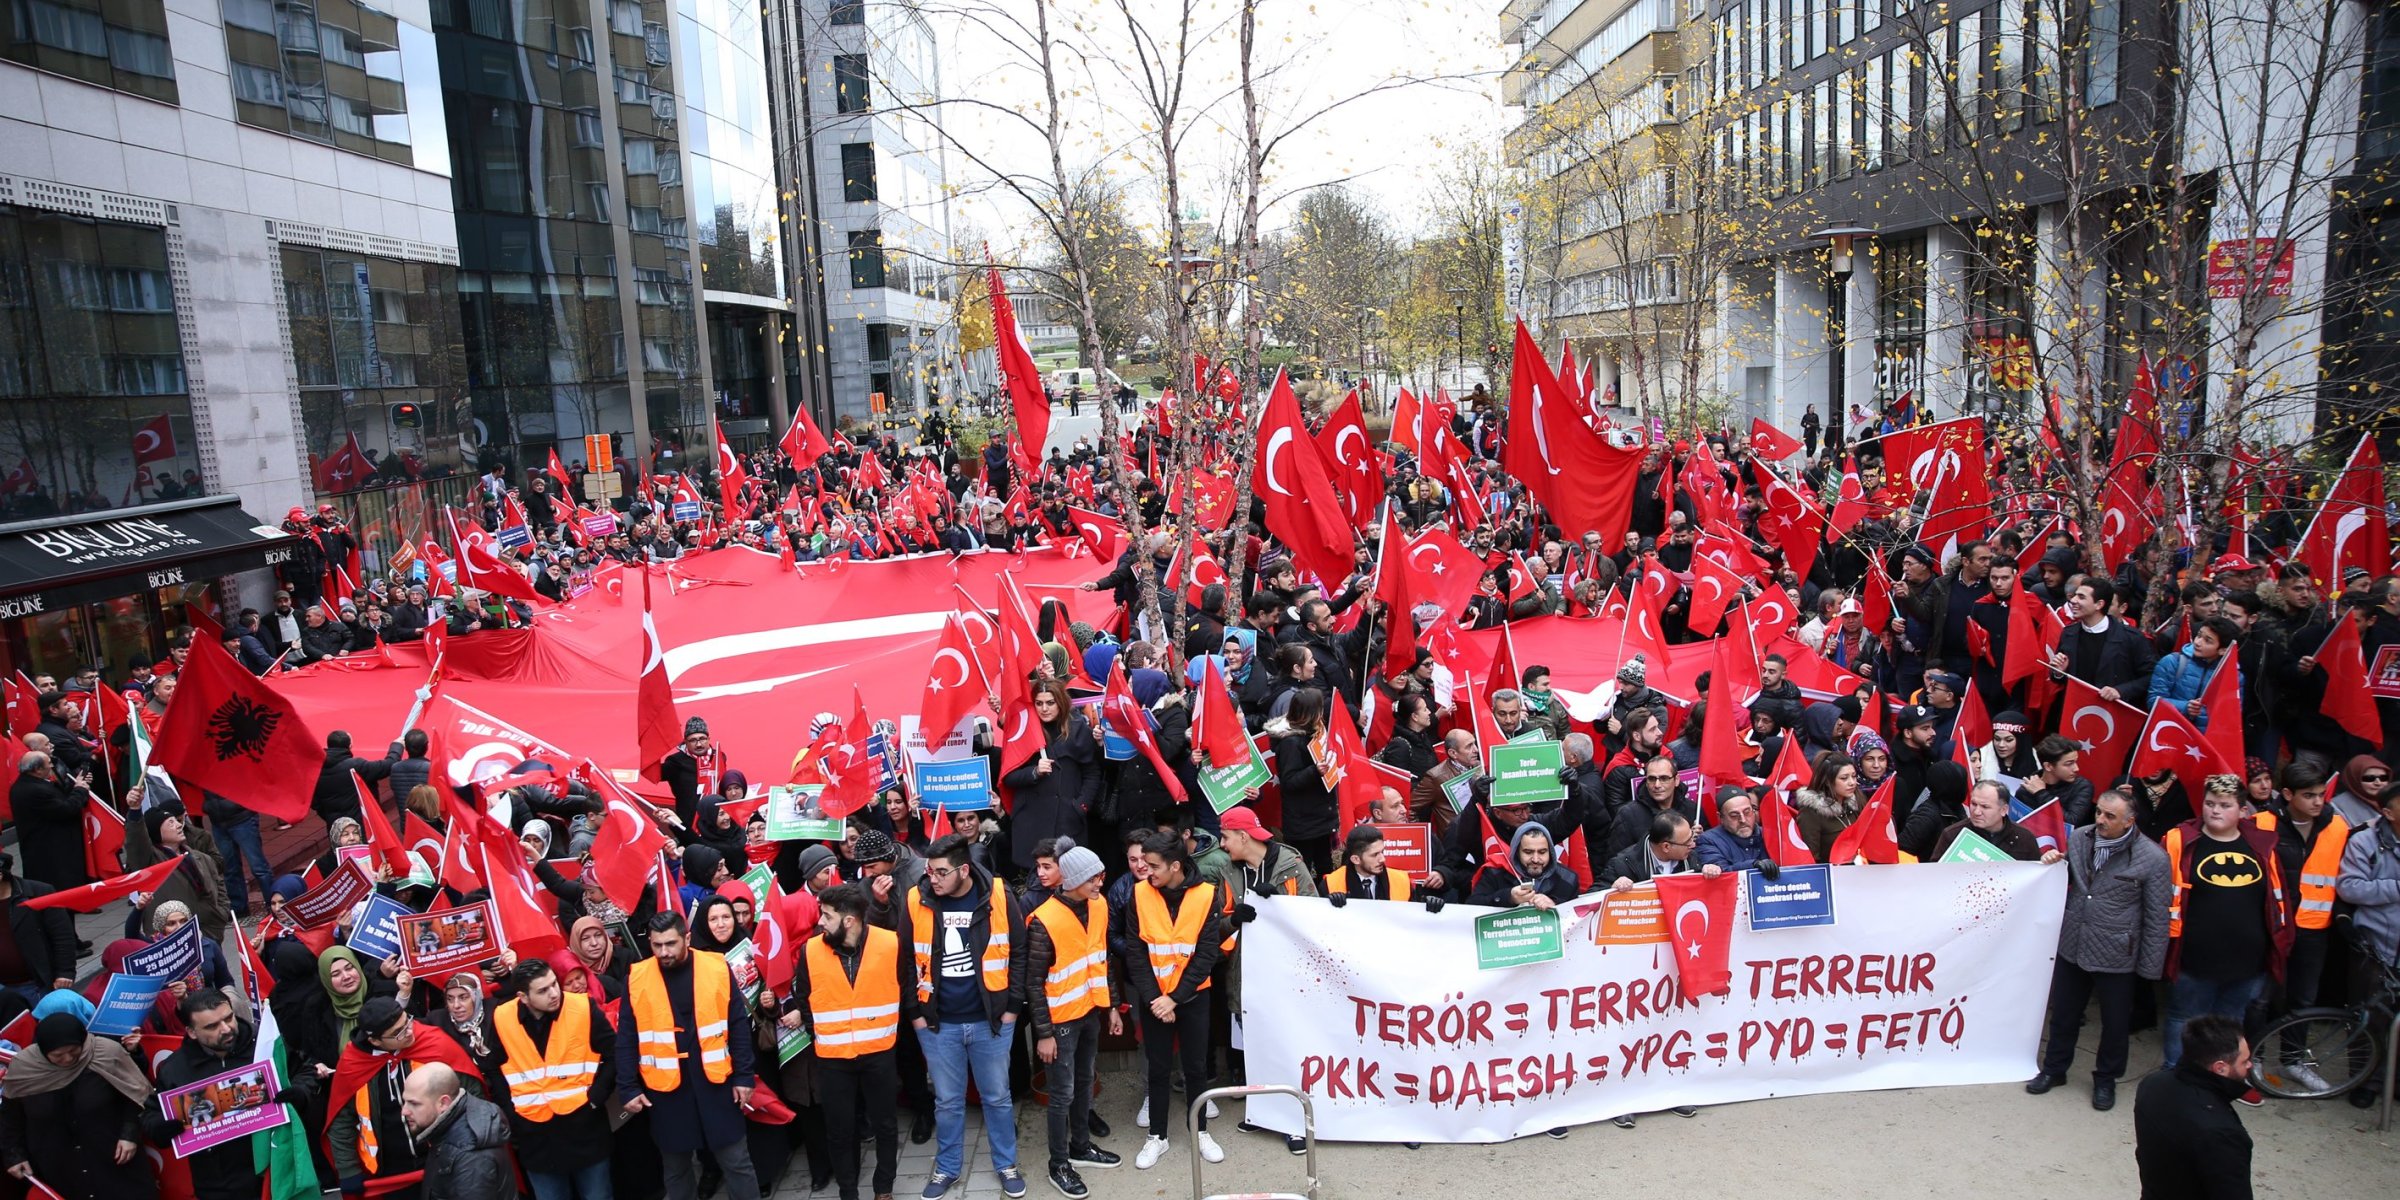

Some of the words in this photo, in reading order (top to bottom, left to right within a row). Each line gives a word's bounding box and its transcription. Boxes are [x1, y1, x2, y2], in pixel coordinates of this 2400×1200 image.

[22, 517, 187, 558] BIGUINE
[264, 550, 292, 564] BIGUINE
[148, 570, 184, 588] BIGUINE
[0, 598, 44, 618] BIGUINE
[931, 782, 960, 792] religion
[967, 781, 984, 789] race
[1787, 882, 1811, 892] destek
[1756, 893, 1792, 904] demokrasi
[944, 916, 970, 926] didas
[1493, 918, 1512, 928] Fight
[1512, 915, 1542, 926] against
[1544, 925, 1554, 933] to
[1497, 937, 1541, 949] Democracy
[133, 950, 163, 968] Turkey
[163, 942, 177, 956] has
[146, 963, 158, 973] 25
[158, 946, 185, 968] Billions
[1347, 990, 1494, 1050] TERÖR
[1504, 1002, 1528, 1038] =
[1744, 952, 1936, 1009] TERREUR
[1301, 1055, 1385, 1106] PKK
[1394, 1072, 1419, 1103] =
[1429, 1052, 1578, 1110] DAESH
[1587, 1055, 1610, 1085] =
[1619, 1029, 1696, 1078] YPG
[1705, 1032, 1728, 1066] =
[1738, 1016, 1814, 1066] PYD
[1824, 1023, 1848, 1058] =
[1857, 995, 1968, 1060] FETÖ
[193, 1126, 207, 1136] Are
[207, 1121, 222, 1131] you
[222, 1118, 236, 1126] not
[236, 1107, 262, 1122] guilty?
[196, 1116, 264, 1140] #StopSupportingTerrorism
